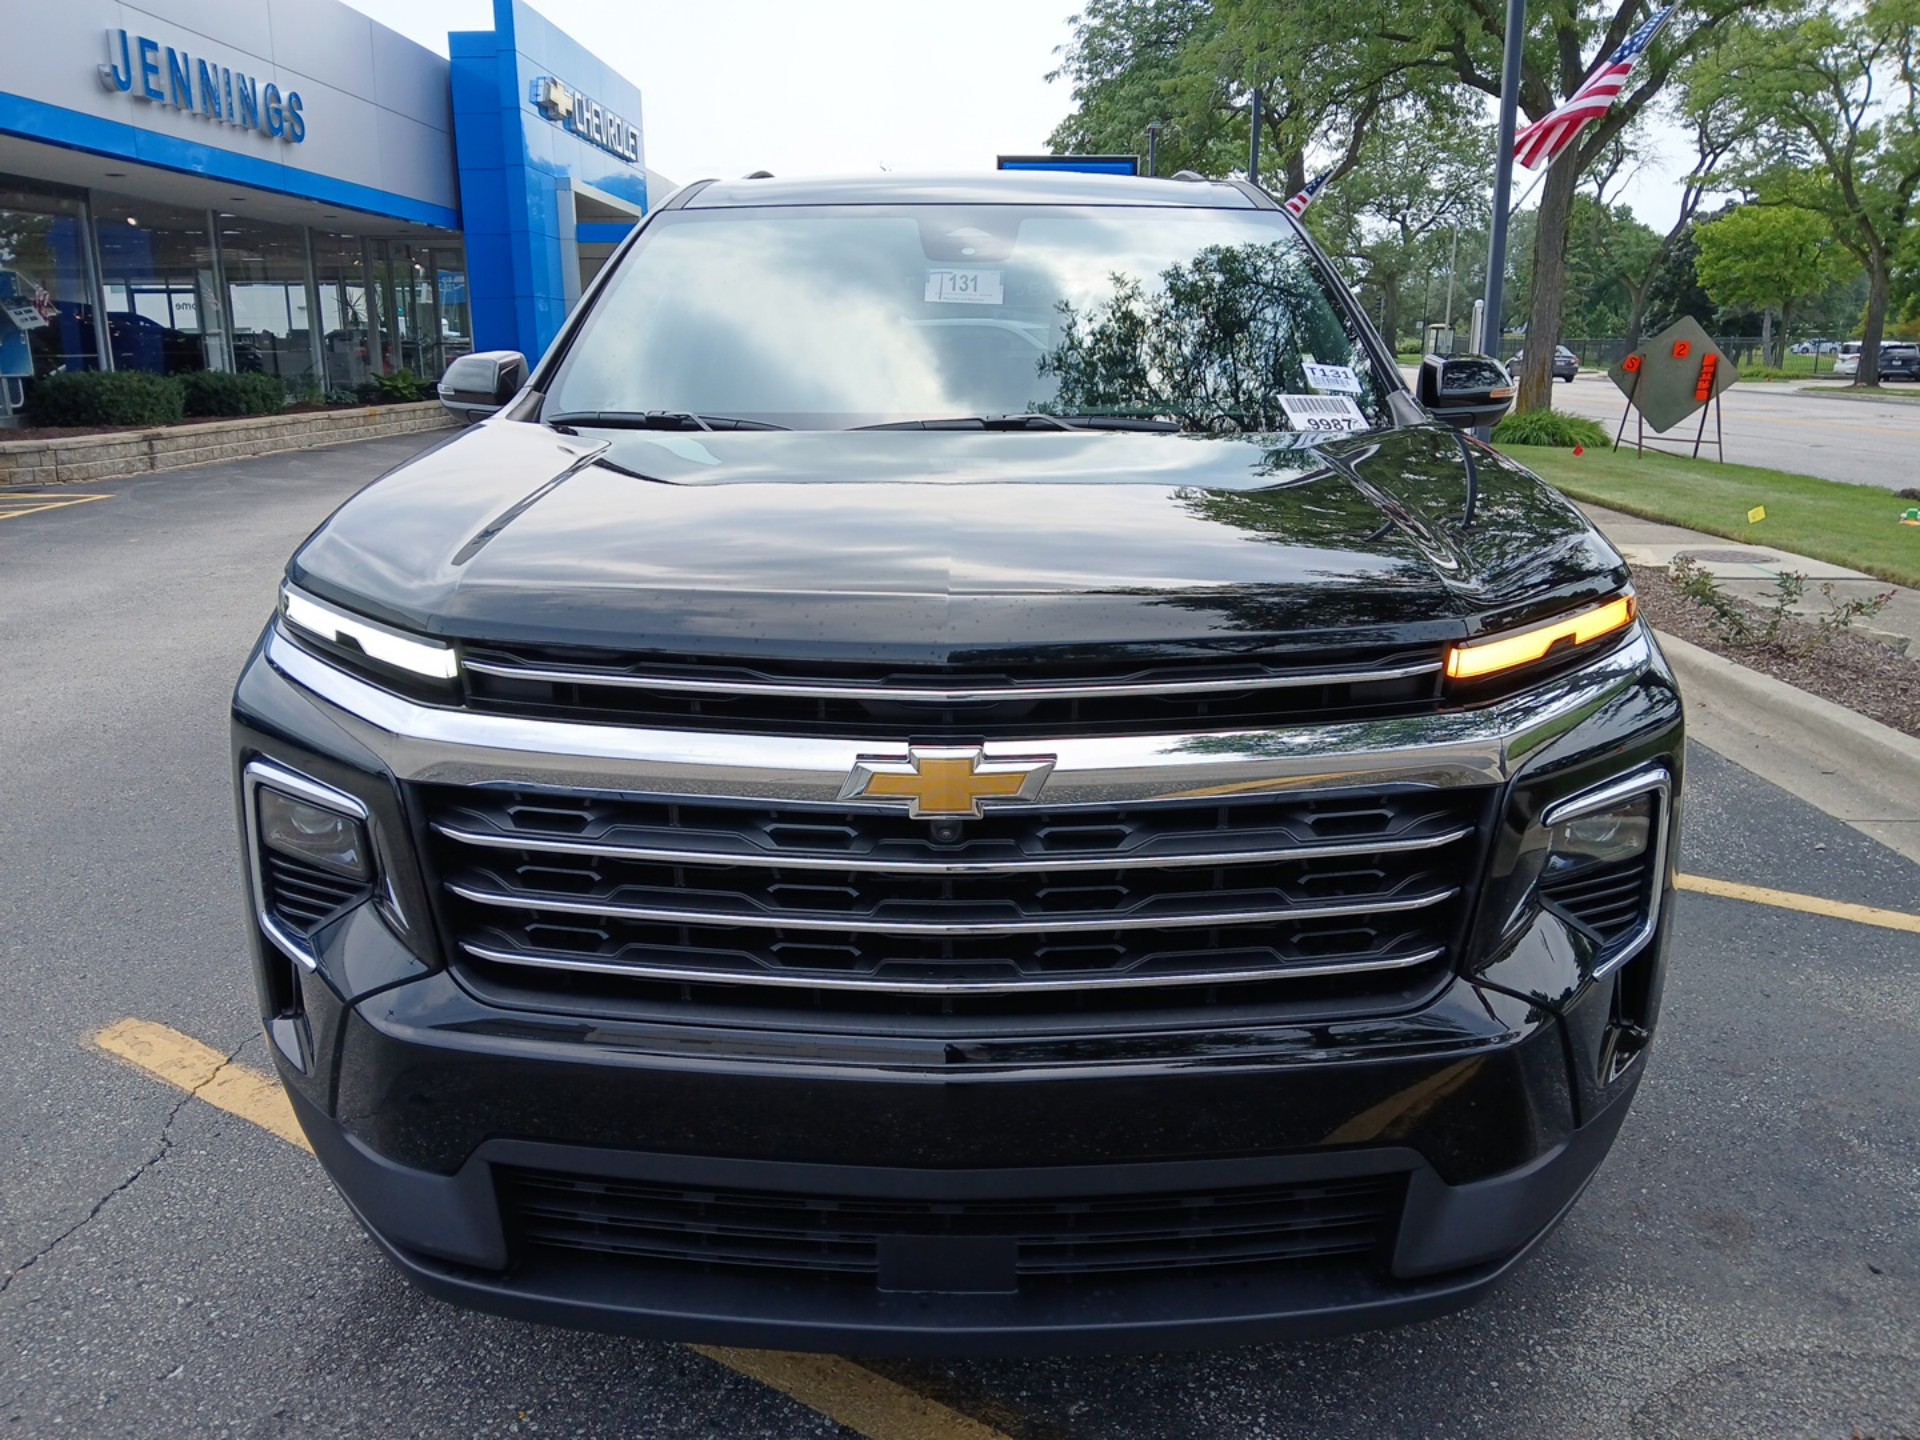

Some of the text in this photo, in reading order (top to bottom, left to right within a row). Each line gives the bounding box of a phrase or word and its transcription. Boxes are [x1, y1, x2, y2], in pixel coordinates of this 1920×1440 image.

[99, 28, 306, 144] JENNINGS
[573, 91, 640, 162] CHEVROLET
[1307, 418, 1353, 431] 9987
